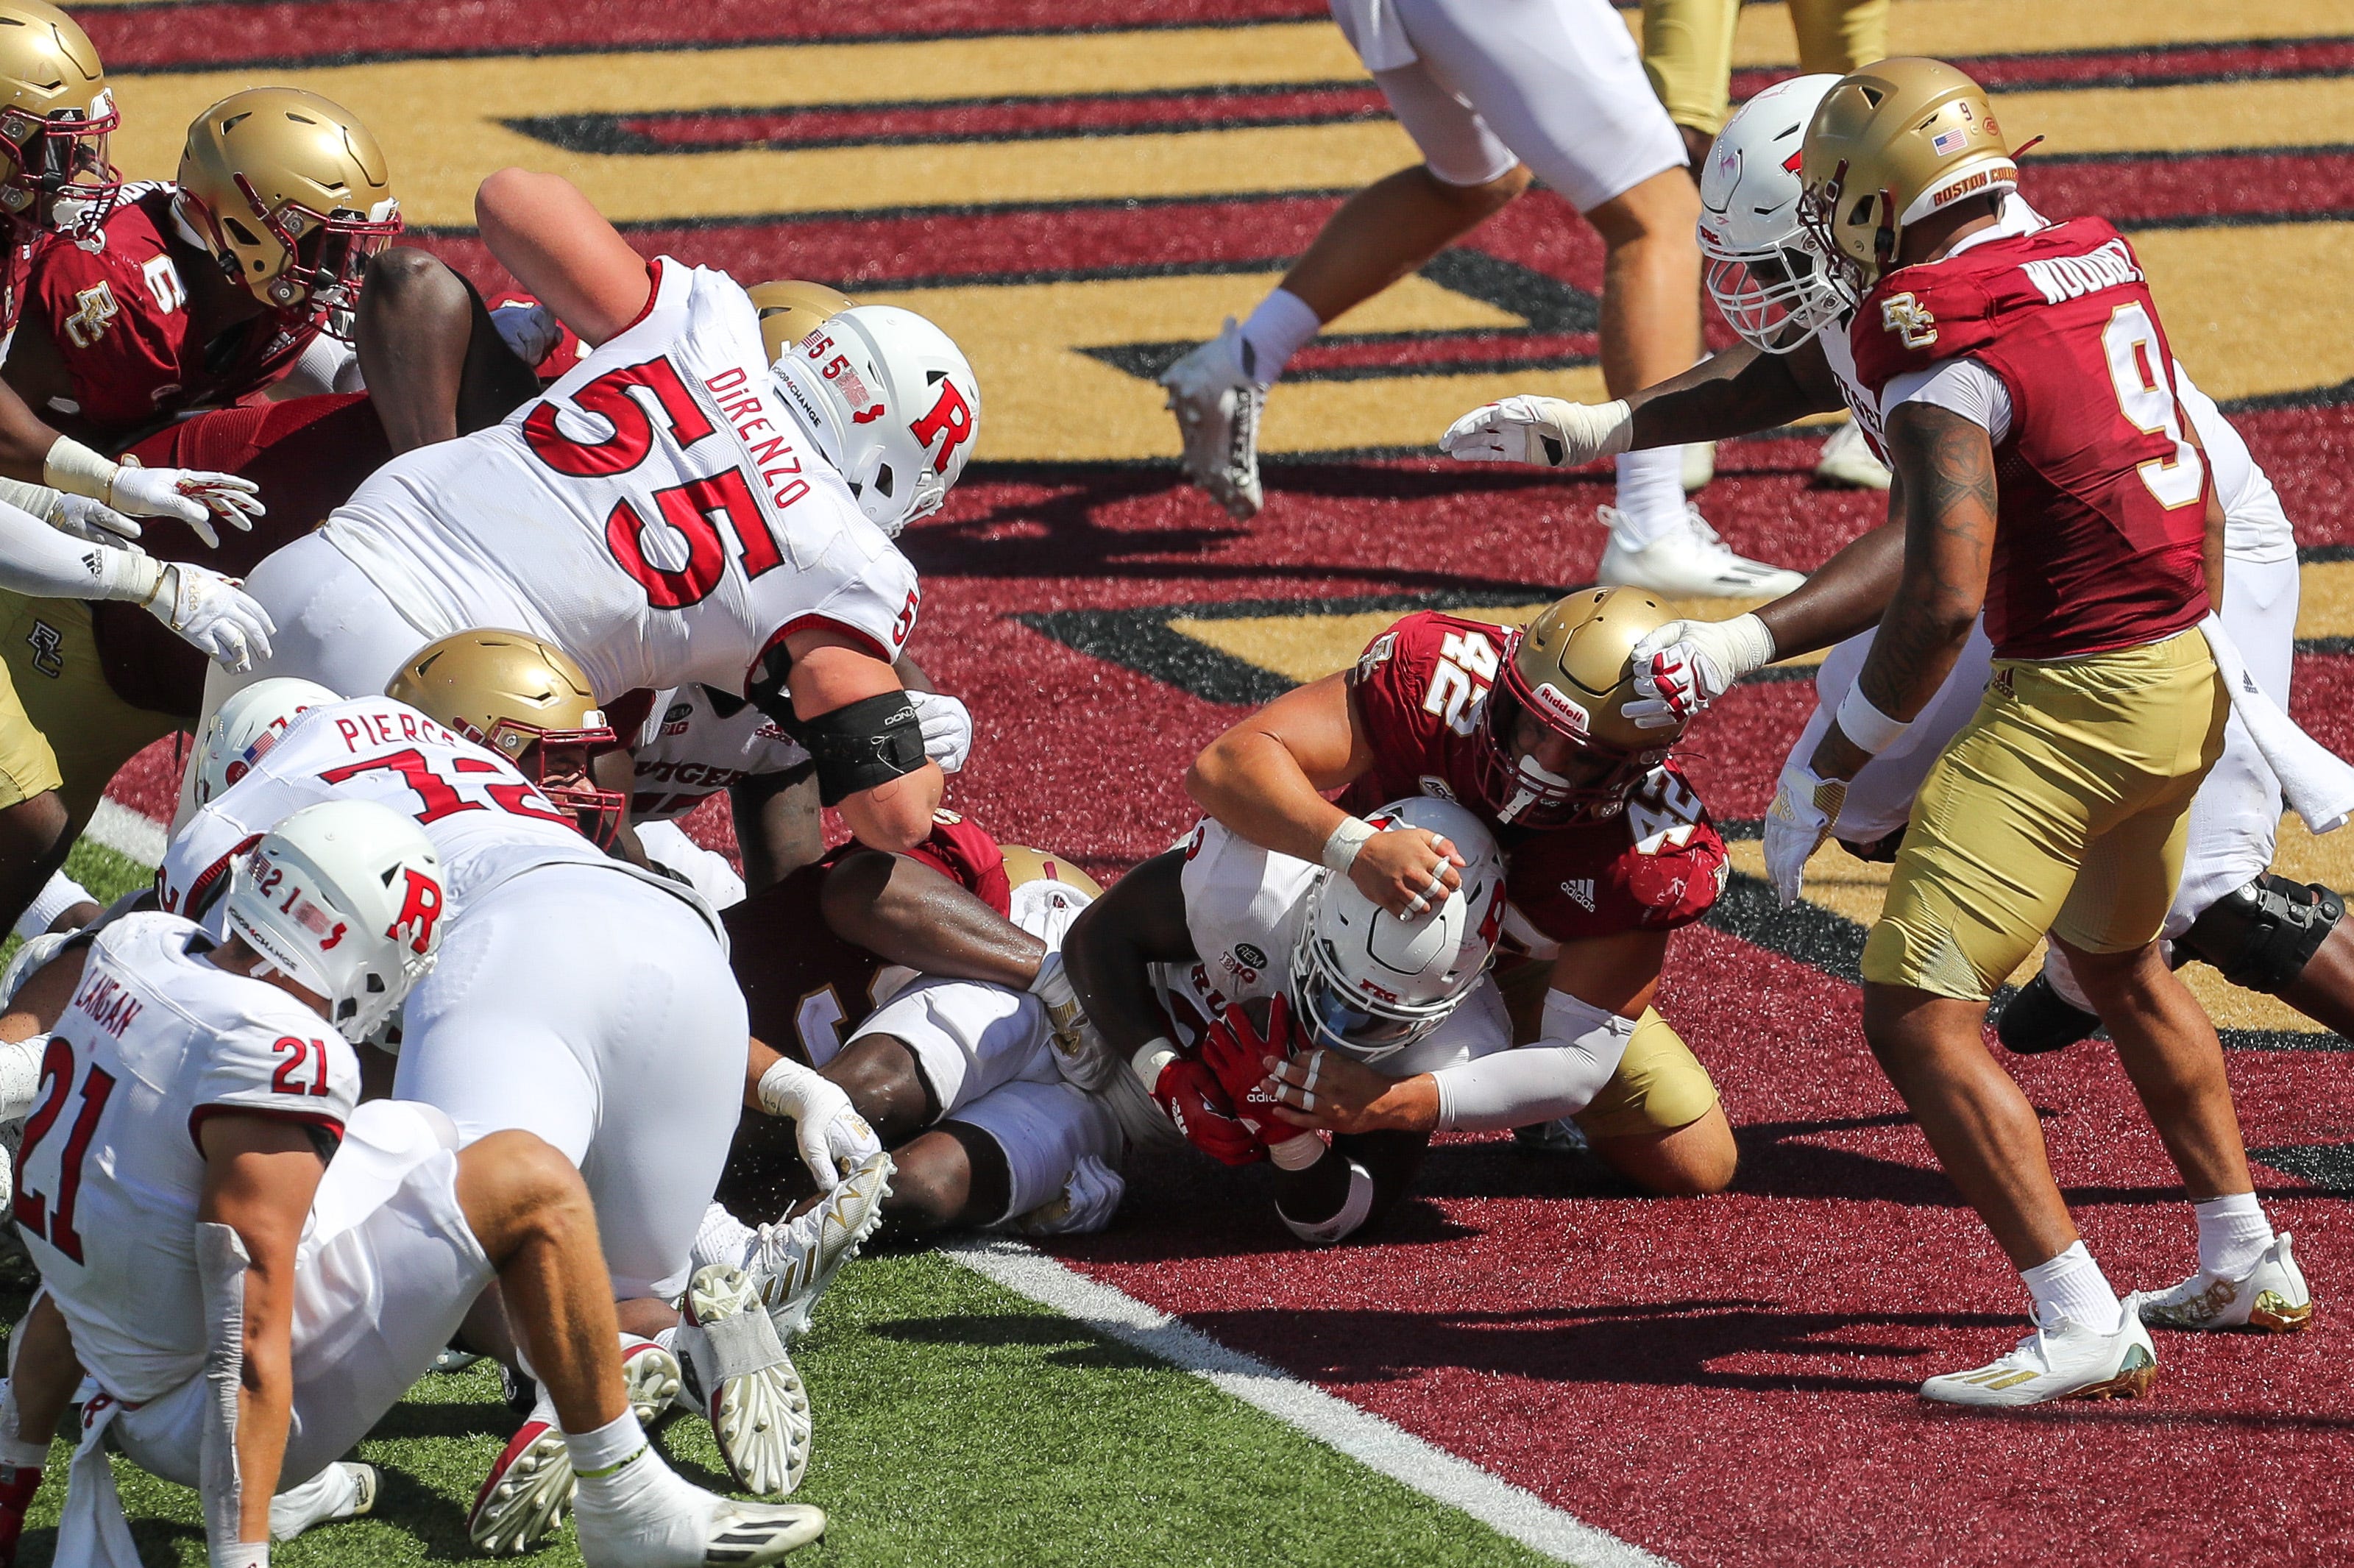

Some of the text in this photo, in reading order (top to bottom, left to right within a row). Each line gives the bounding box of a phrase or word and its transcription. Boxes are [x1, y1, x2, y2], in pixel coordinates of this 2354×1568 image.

[1959, 102, 1973, 121] 9
[1933, 171, 1988, 207] BOSTON
[808, 336, 849, 380] 55
[704, 367, 810, 509] DiRENZO
[909, 377, 972, 475] R
[2100, 299, 2205, 511] 9
[522, 354, 784, 610] 55
[1422, 631, 1501, 738] 42
[1541, 688, 1583, 723] Riddell
[1626, 765, 1704, 856] 42
[259, 868, 302, 915] 21
[385, 866, 442, 955] R
[1560, 881, 1596, 913] adidas
[1237, 946, 1264, 967] REM
[74, 967, 143, 1040] LANGAN
[270, 1036, 330, 1097] 21
[13, 1036, 116, 1267] 21
